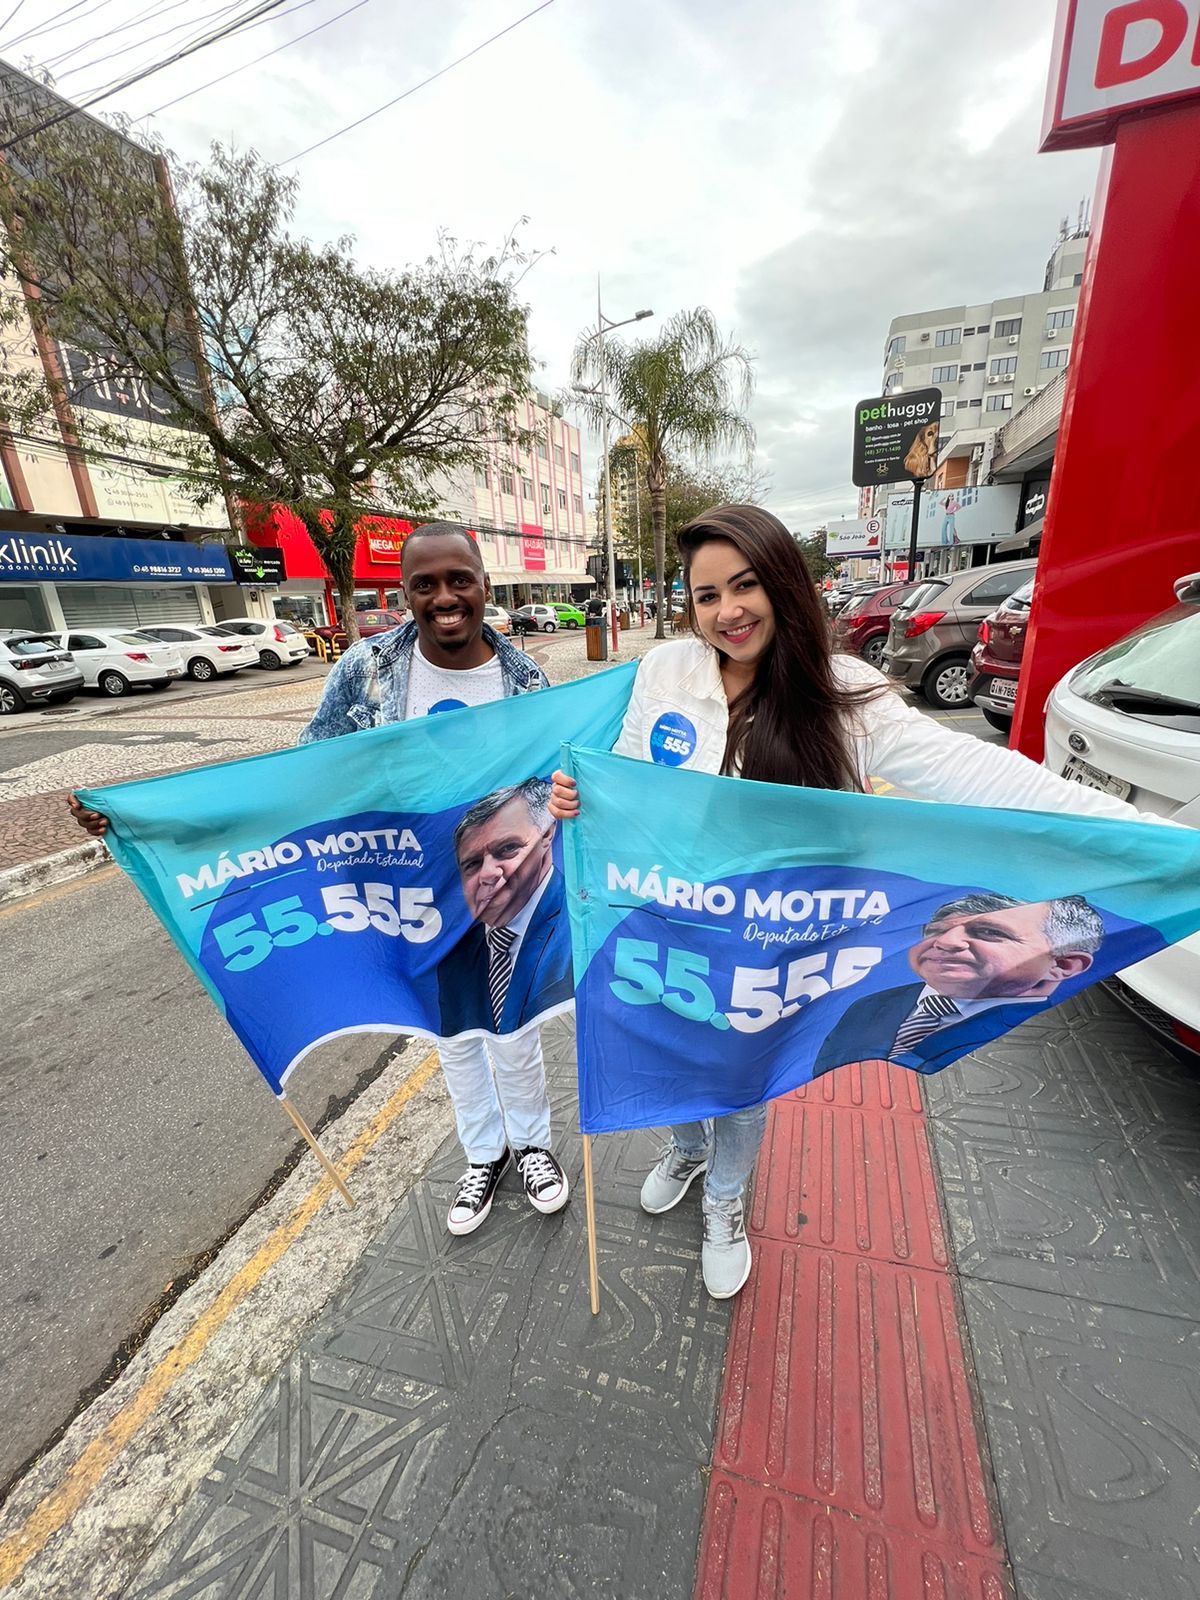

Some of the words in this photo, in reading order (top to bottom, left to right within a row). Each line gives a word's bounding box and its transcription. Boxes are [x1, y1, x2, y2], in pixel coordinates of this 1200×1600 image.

[1094, 0, 1200, 89] D
[860, 401, 935, 425] pethuggy
[914, 417, 928, 425] shop
[870, 522, 876, 531] E
[176, 841, 302, 898] MÁRIO
[306, 829, 422, 857] MOTTA
[317, 851, 374, 873] Deputado
[375, 852, 424, 868] Estadual
[607, 862, 735, 915] MÁRIO
[744, 889, 891, 922] MOTTA
[213, 883, 443, 972] 55.555
[743, 922, 818, 950] Deputado
